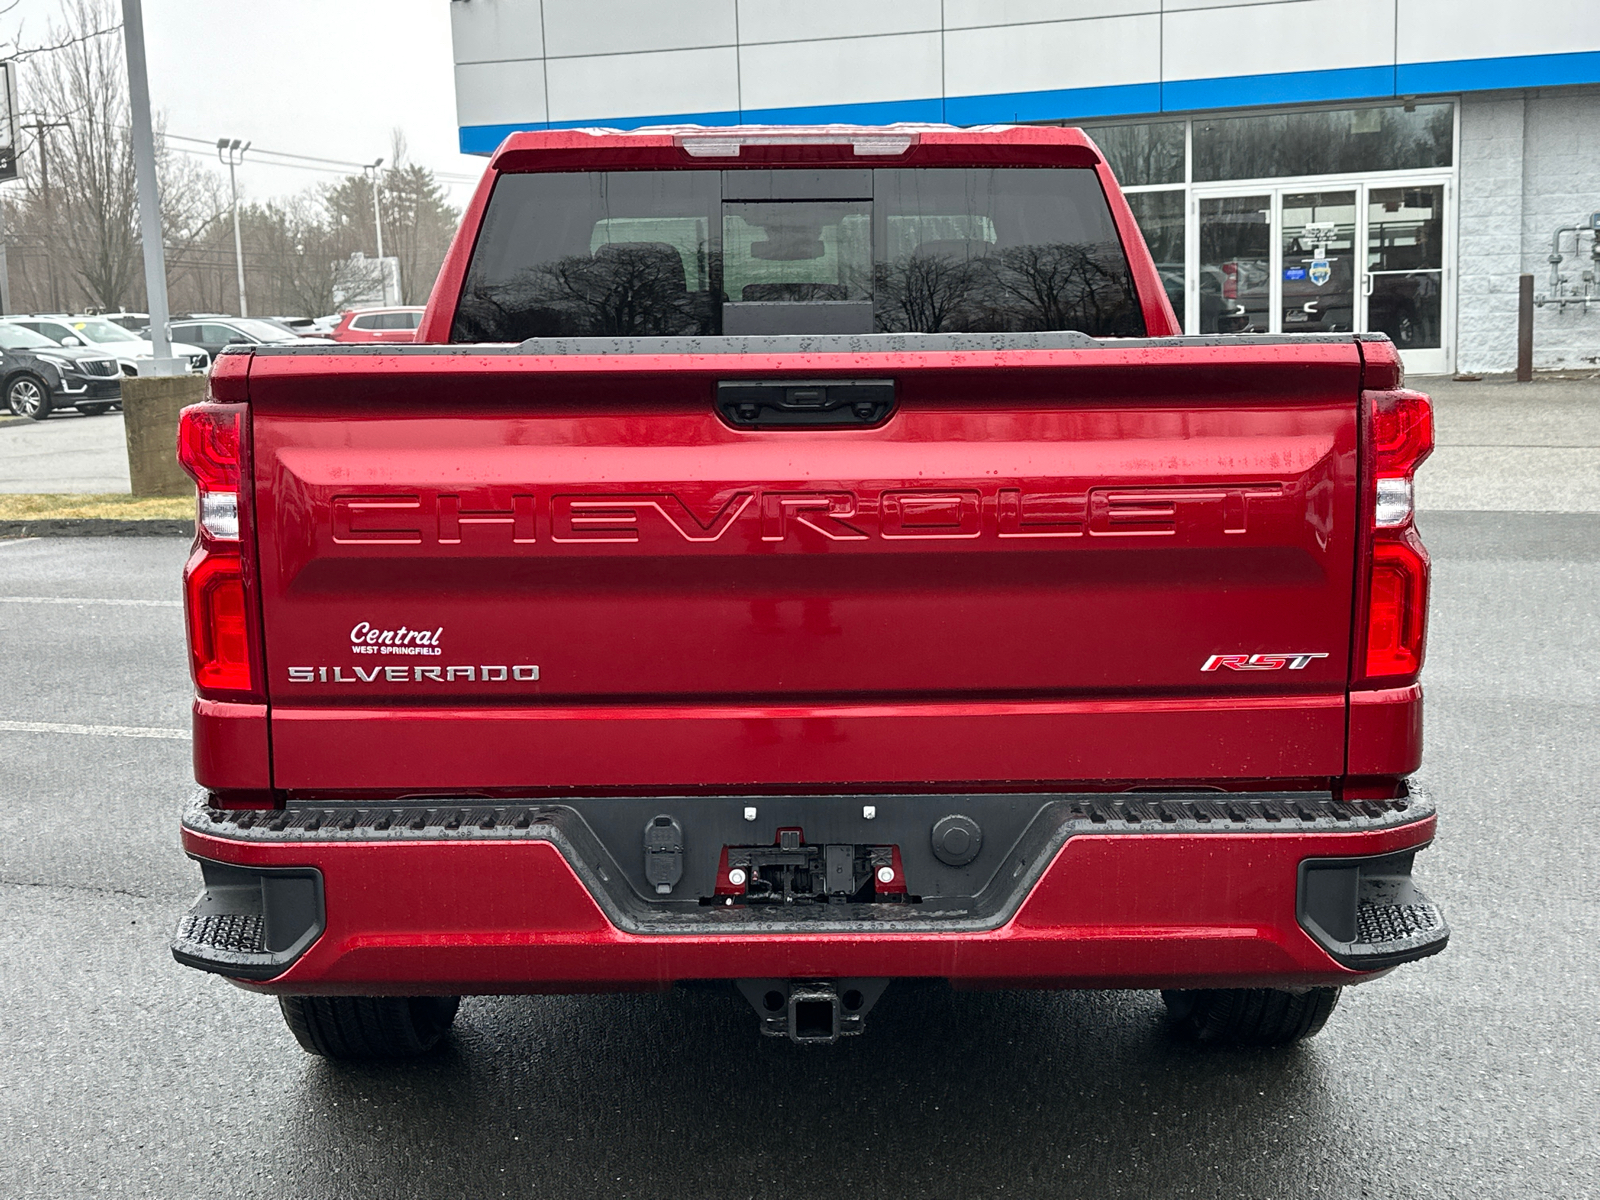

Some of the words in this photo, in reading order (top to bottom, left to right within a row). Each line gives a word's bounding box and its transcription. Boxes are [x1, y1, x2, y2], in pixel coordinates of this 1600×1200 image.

[331, 481, 1284, 545] CHEVROLET
[350, 621, 444, 646] Central
[351, 646, 378, 655] WEST
[380, 646, 442, 656] SPRINGFIELD
[1200, 652, 1330, 672] RST
[287, 664, 540, 683] SILVERADO
